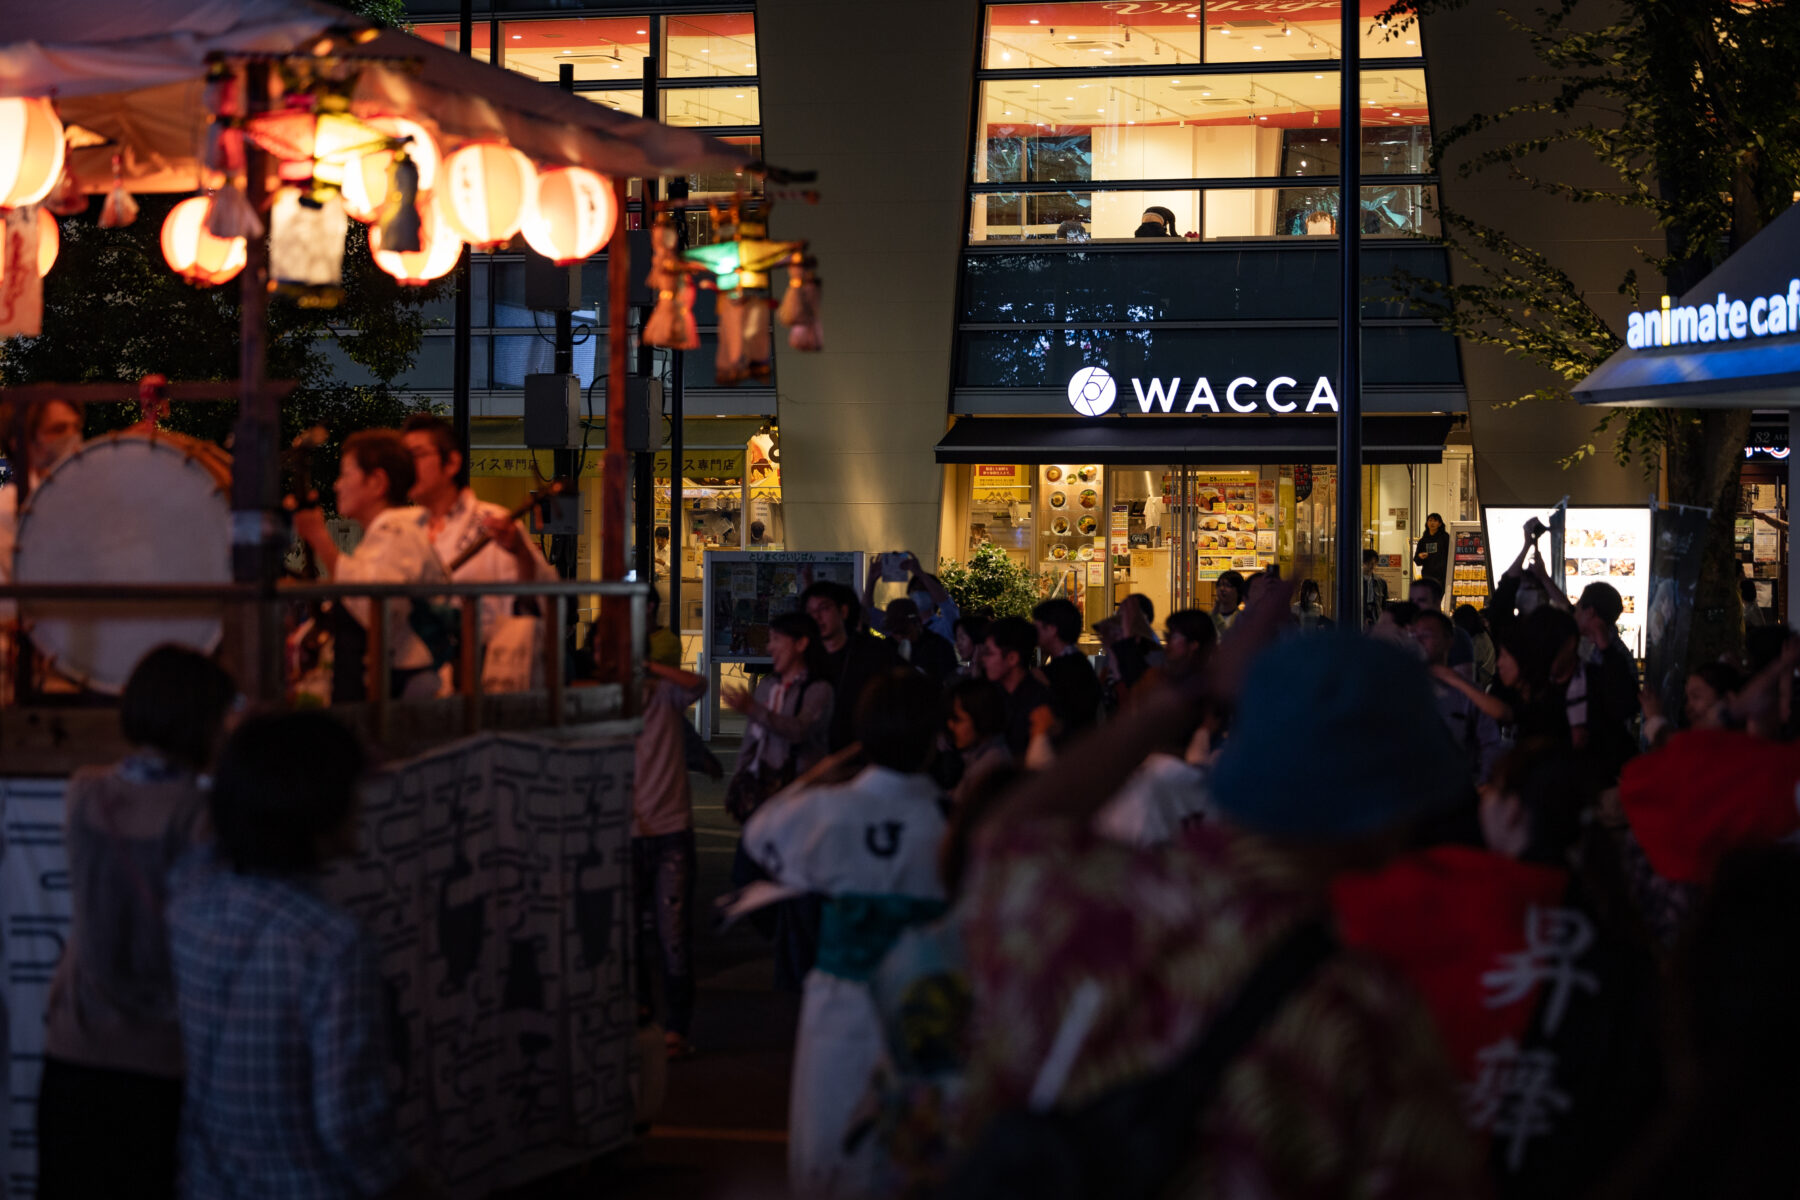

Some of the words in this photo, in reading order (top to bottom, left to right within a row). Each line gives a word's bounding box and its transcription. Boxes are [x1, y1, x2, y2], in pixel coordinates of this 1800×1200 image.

[1627, 292, 1748, 350] animate
[1750, 278, 1800, 337] caf
[1131, 376, 1339, 413] WACCA
[749, 552, 816, 561] としまくけいじばん
